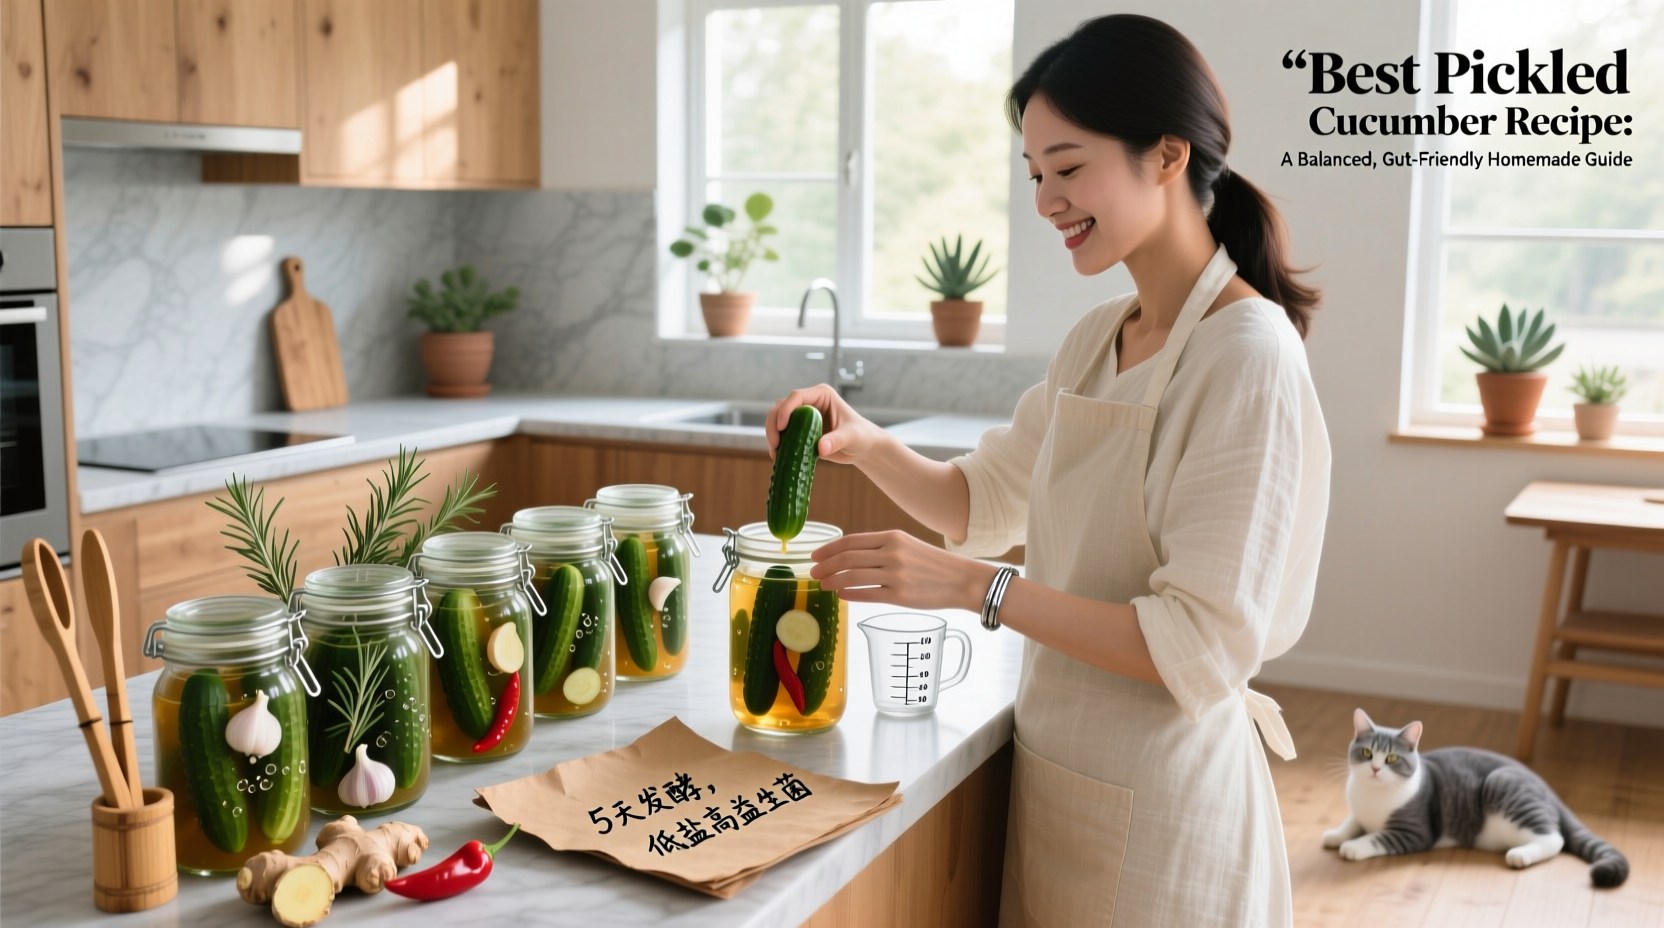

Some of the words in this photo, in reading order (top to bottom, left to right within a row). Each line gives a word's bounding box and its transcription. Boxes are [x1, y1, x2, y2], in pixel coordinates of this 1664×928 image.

[648, 772, 813, 857] 低盐高益生菌
